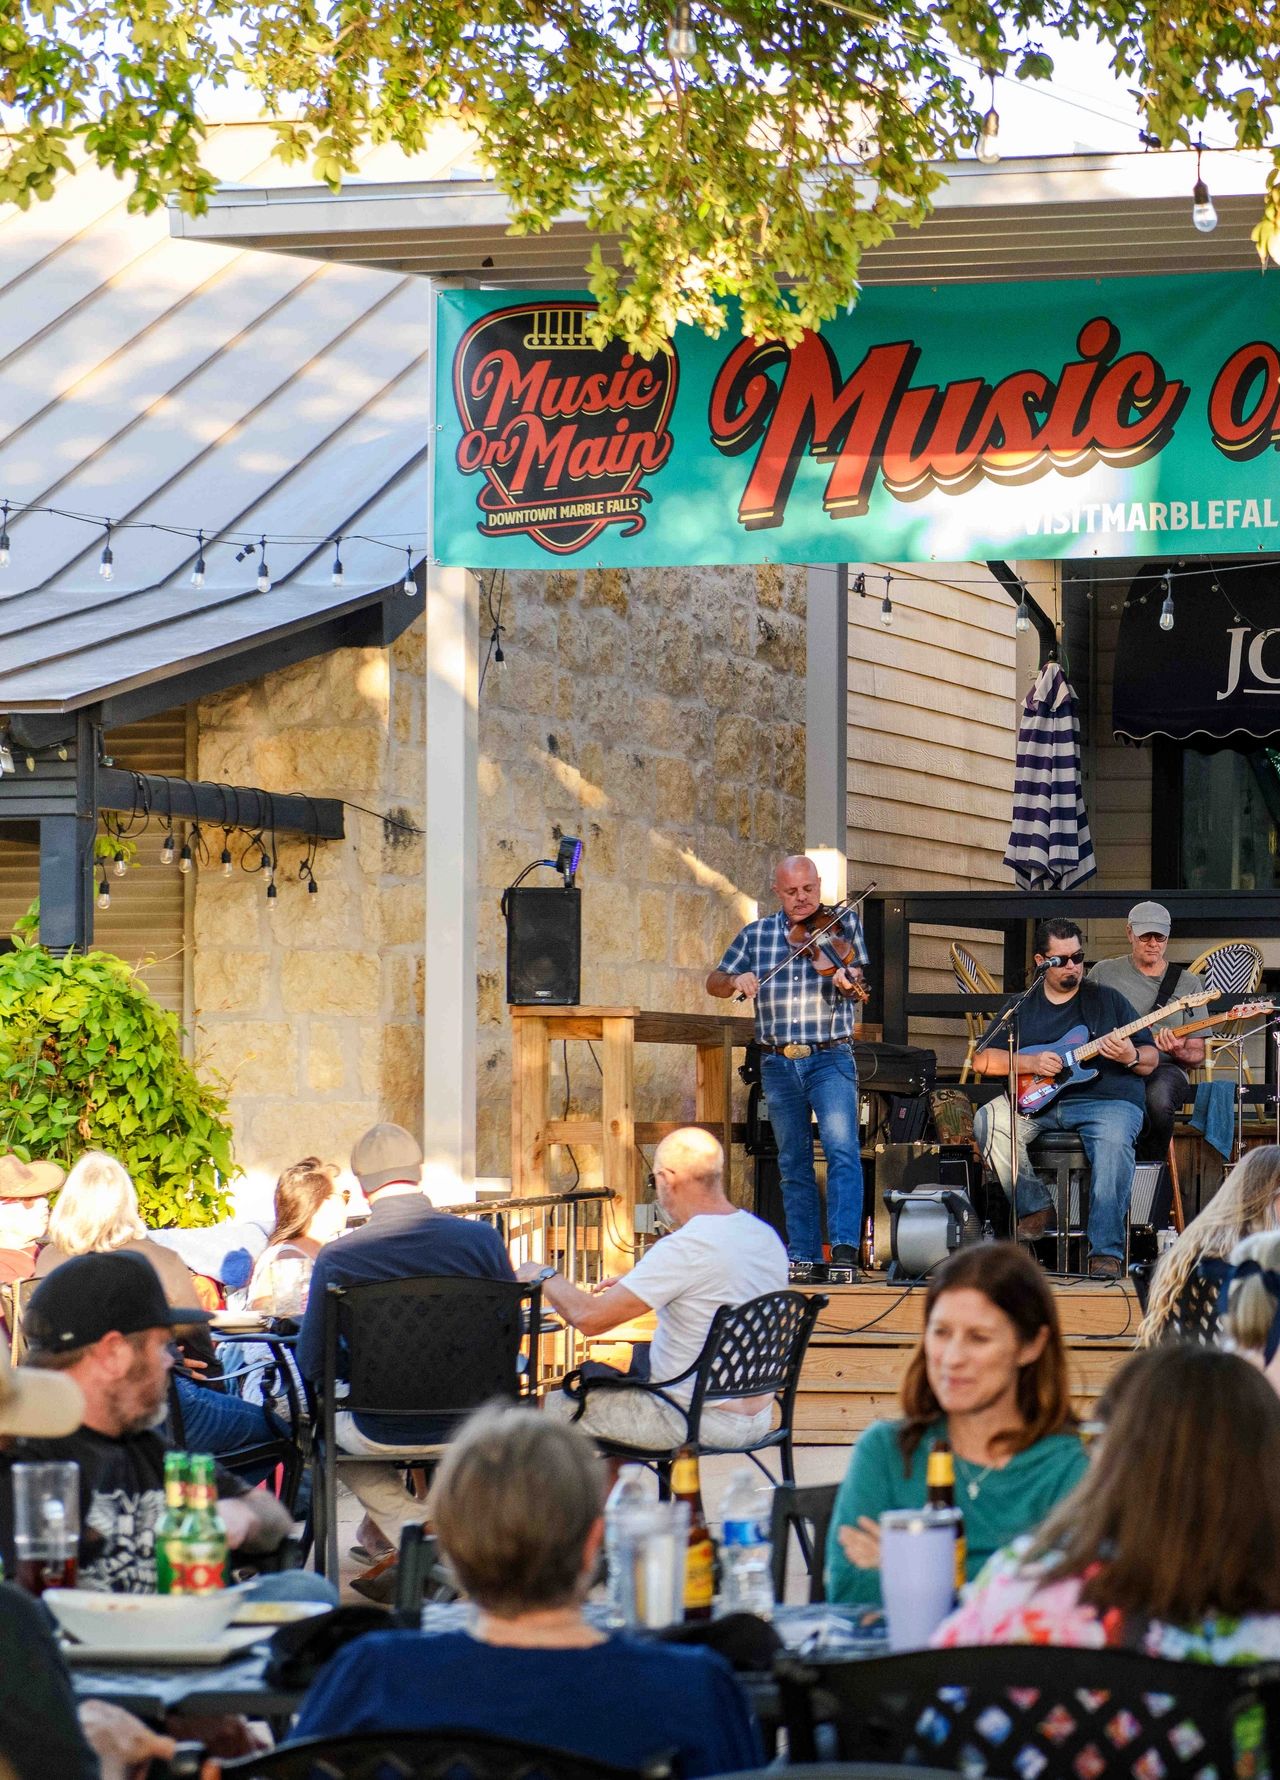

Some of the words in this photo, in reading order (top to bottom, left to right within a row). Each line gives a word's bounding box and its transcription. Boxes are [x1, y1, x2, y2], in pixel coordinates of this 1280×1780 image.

[471, 349, 662, 431] Music
[712, 318, 1188, 529] Music
[457, 430, 521, 473] On
[501, 412, 672, 495] Main
[488, 506, 558, 527] DOWNTOWN
[559, 501, 604, 518] MARBLE
[606, 497, 639, 513] FALLS
